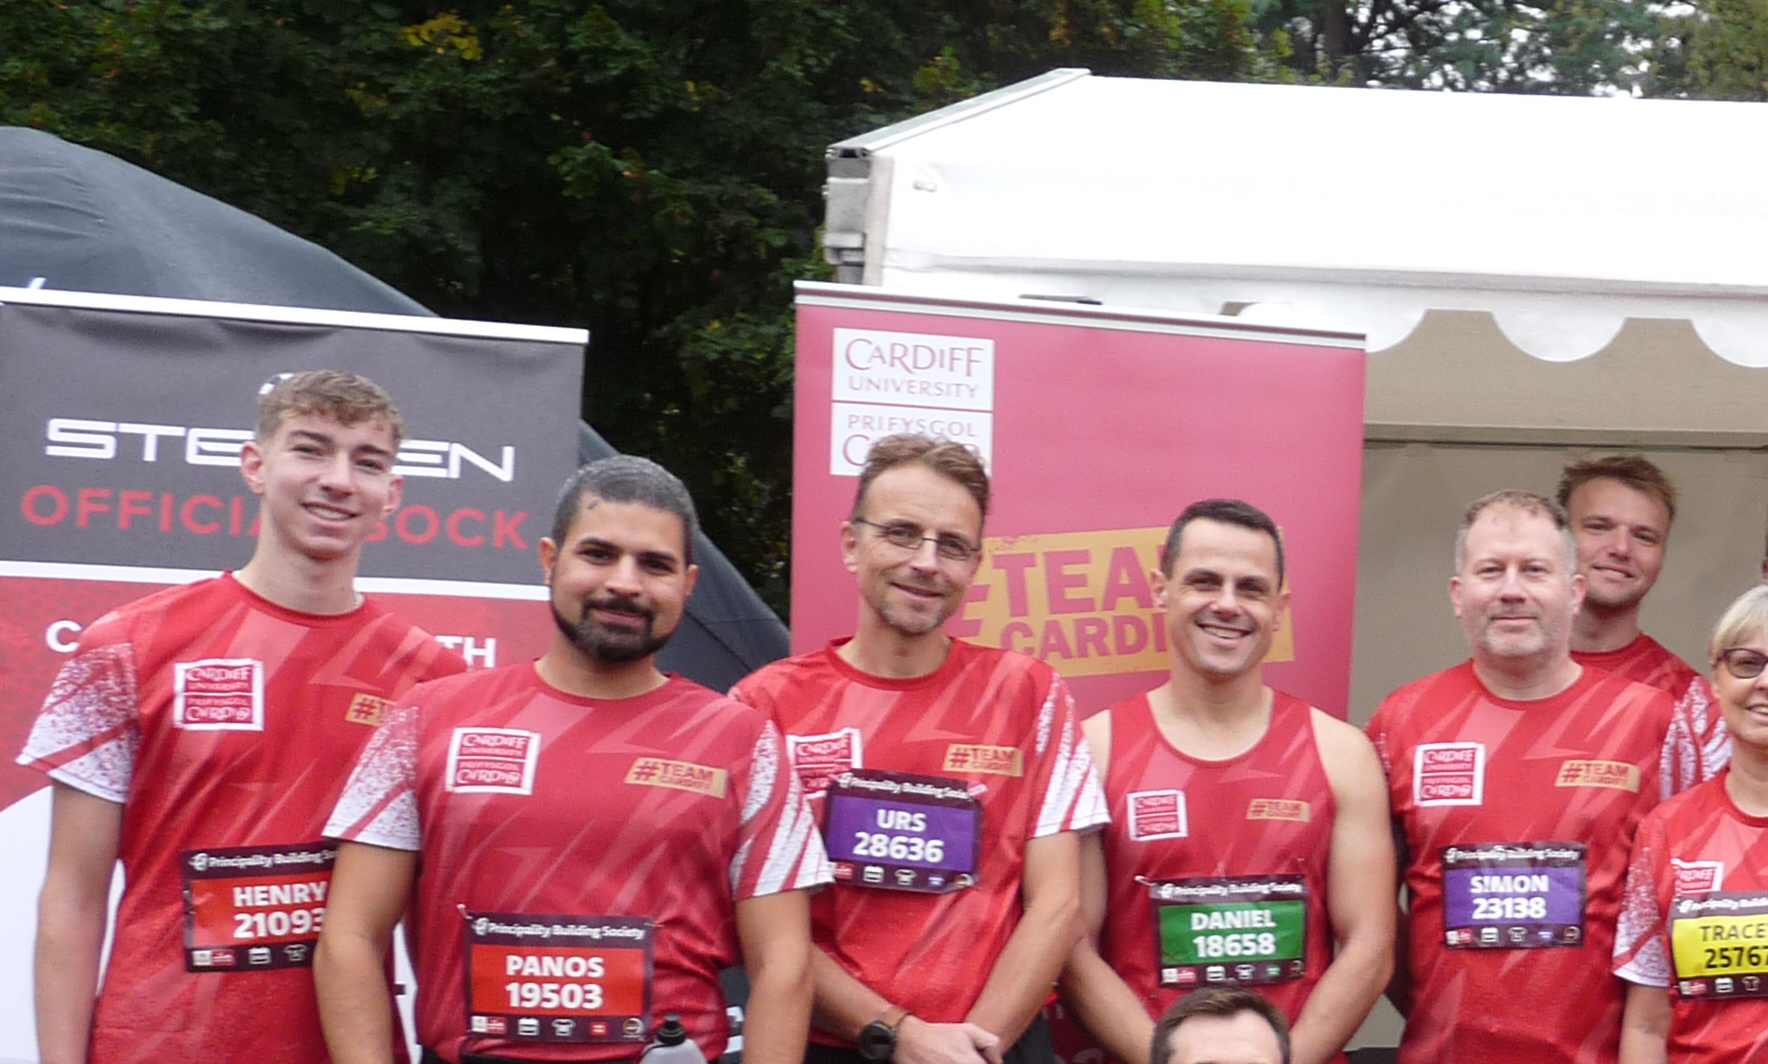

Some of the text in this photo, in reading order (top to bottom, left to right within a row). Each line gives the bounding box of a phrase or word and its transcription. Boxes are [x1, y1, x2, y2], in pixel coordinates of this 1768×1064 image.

[845, 338, 986, 377] CARDIFF
[848, 376, 979, 398] UNIVERSITY
[847, 414, 978, 437] PRIFYSGOL
[46, 418, 515, 482] STEEN
[21, 485, 259, 536] OFFICI
[1001, 612, 1168, 660] CARDI
[462, 734, 528, 749] CARDIFF
[876, 808, 927, 832] URS
[852, 831, 945, 863] 28636
[208, 853, 273, 868] Principality
[232, 881, 327, 907] HENRY
[1469, 874, 1549, 893] SIMON
[1190, 910, 1277, 930] DANIEL
[1471, 897, 1547, 920] 23138
[232, 907, 327, 939] 21093
[488, 924, 646, 940] Principality Building Society
[1192, 932, 1277, 957] 18658
[505, 954, 606, 978] PANOS
[505, 982, 604, 1010] 19503
